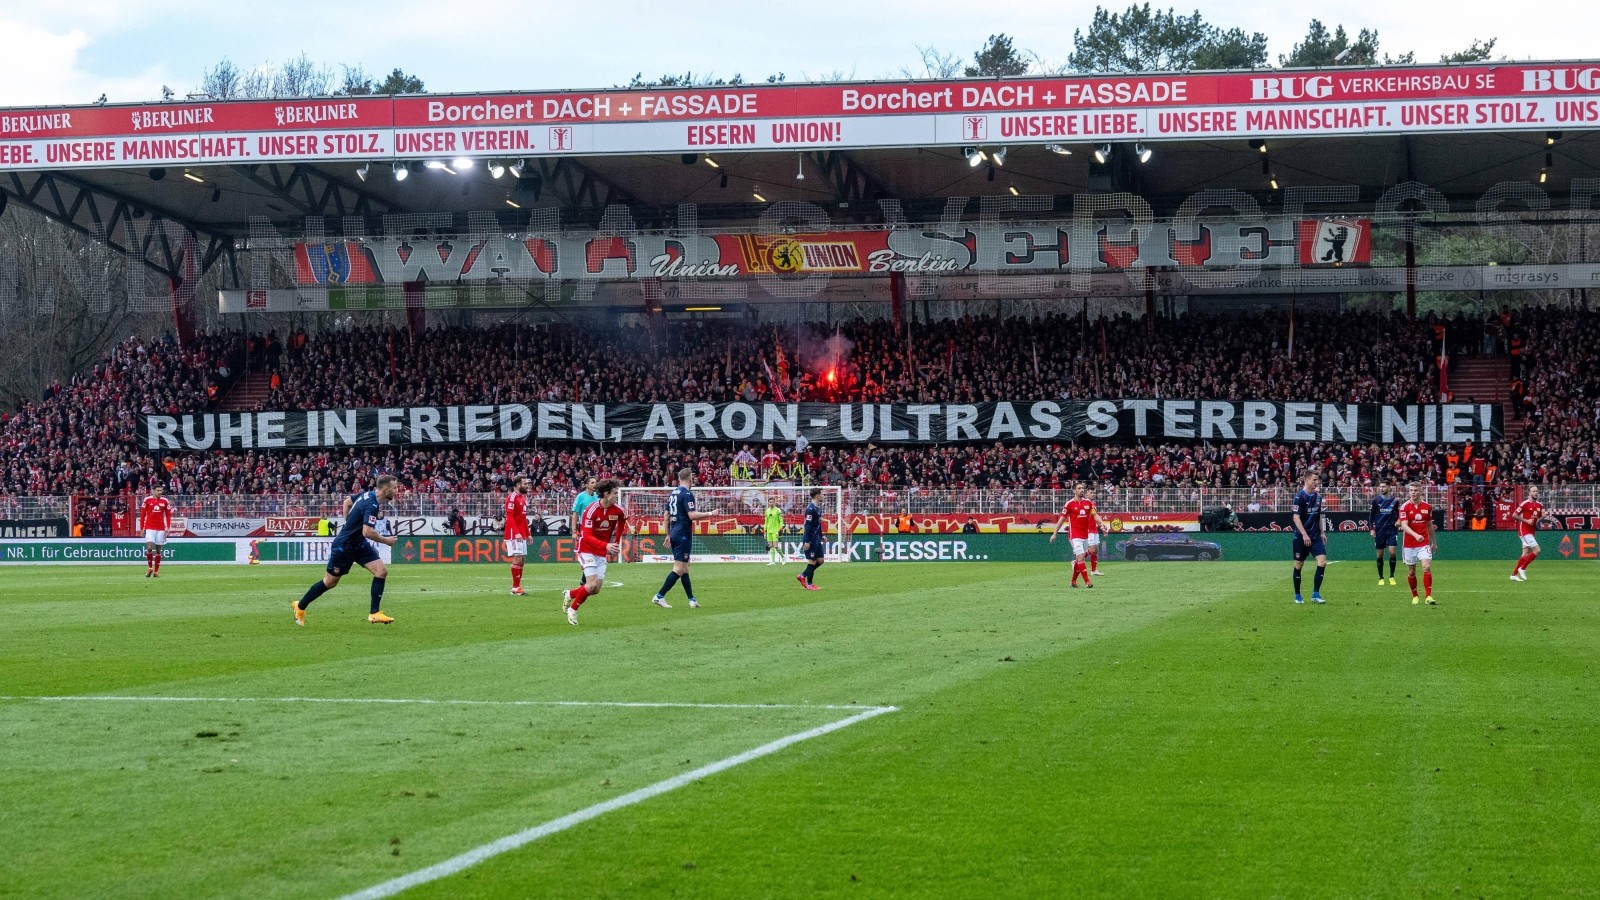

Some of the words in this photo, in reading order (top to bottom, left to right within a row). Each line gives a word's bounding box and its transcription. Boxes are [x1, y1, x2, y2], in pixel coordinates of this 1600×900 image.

[1250, 75, 1334, 100] BUG
[1339, 75, 1470, 94] VERKEHRSBAU
[1475, 74, 1495, 90] SE
[1521, 68, 1600, 92] BUG
[428, 99, 534, 122] Borchert
[543, 96, 611, 119] DACH
[618, 101, 632, 117] +
[640, 94, 758, 117] FASSADE
[842, 87, 952, 111] Borchert
[962, 85, 1034, 108] DACH
[1042, 90, 1057, 105] +
[1065, 81, 1187, 105] FASSADE
[2, 113, 72, 134] BERLINER
[142, 107, 214, 129] BERLINER
[286, 103, 358, 124] BERLINER
[1000, 115, 1078, 137] UNSERE
[1083, 113, 1145, 135] LIEBE.
[1158, 111, 1237, 133] UNSERE
[1246, 106, 1392, 131] MANNSCHAFT.
[1401, 103, 1469, 126] UNSER
[1475, 102, 1545, 124] STOLZ.
[1555, 100, 1600, 122] UNS
[47, 142, 116, 163] UNSERE
[123, 137, 250, 161] MANNSCHAFT.
[258, 135, 318, 156] UNSER
[323, 133, 385, 155] STOLZ.
[395, 132, 456, 153] UNSER
[462, 129, 536, 151] VEREIN.
[688, 124, 756, 146] EISERN
[772, 122, 842, 144] UNION!
[650, 249, 740, 278] Union
[867, 249, 959, 273] Berlin
[804, 243, 860, 269] UNION
[1495, 268, 1559, 284] migrasys
[147, 411, 286, 450] RUHE
[307, 409, 357, 447] IN
[378, 403, 622, 445] FRIEDEN,
[642, 403, 798, 441] ARON
[840, 401, 1062, 441] ULTRAS
[1086, 400, 1358, 442] STERBEN
[1381, 403, 1492, 443] NIE!
[1499, 503, 1511, 511] Tor
[192, 522, 250, 531] PILS-PIRANHAS
[42, 547, 59, 558] für
[64, 546, 175, 558] Gebrauchtroboer
[556, 538, 655, 562] ERIS
